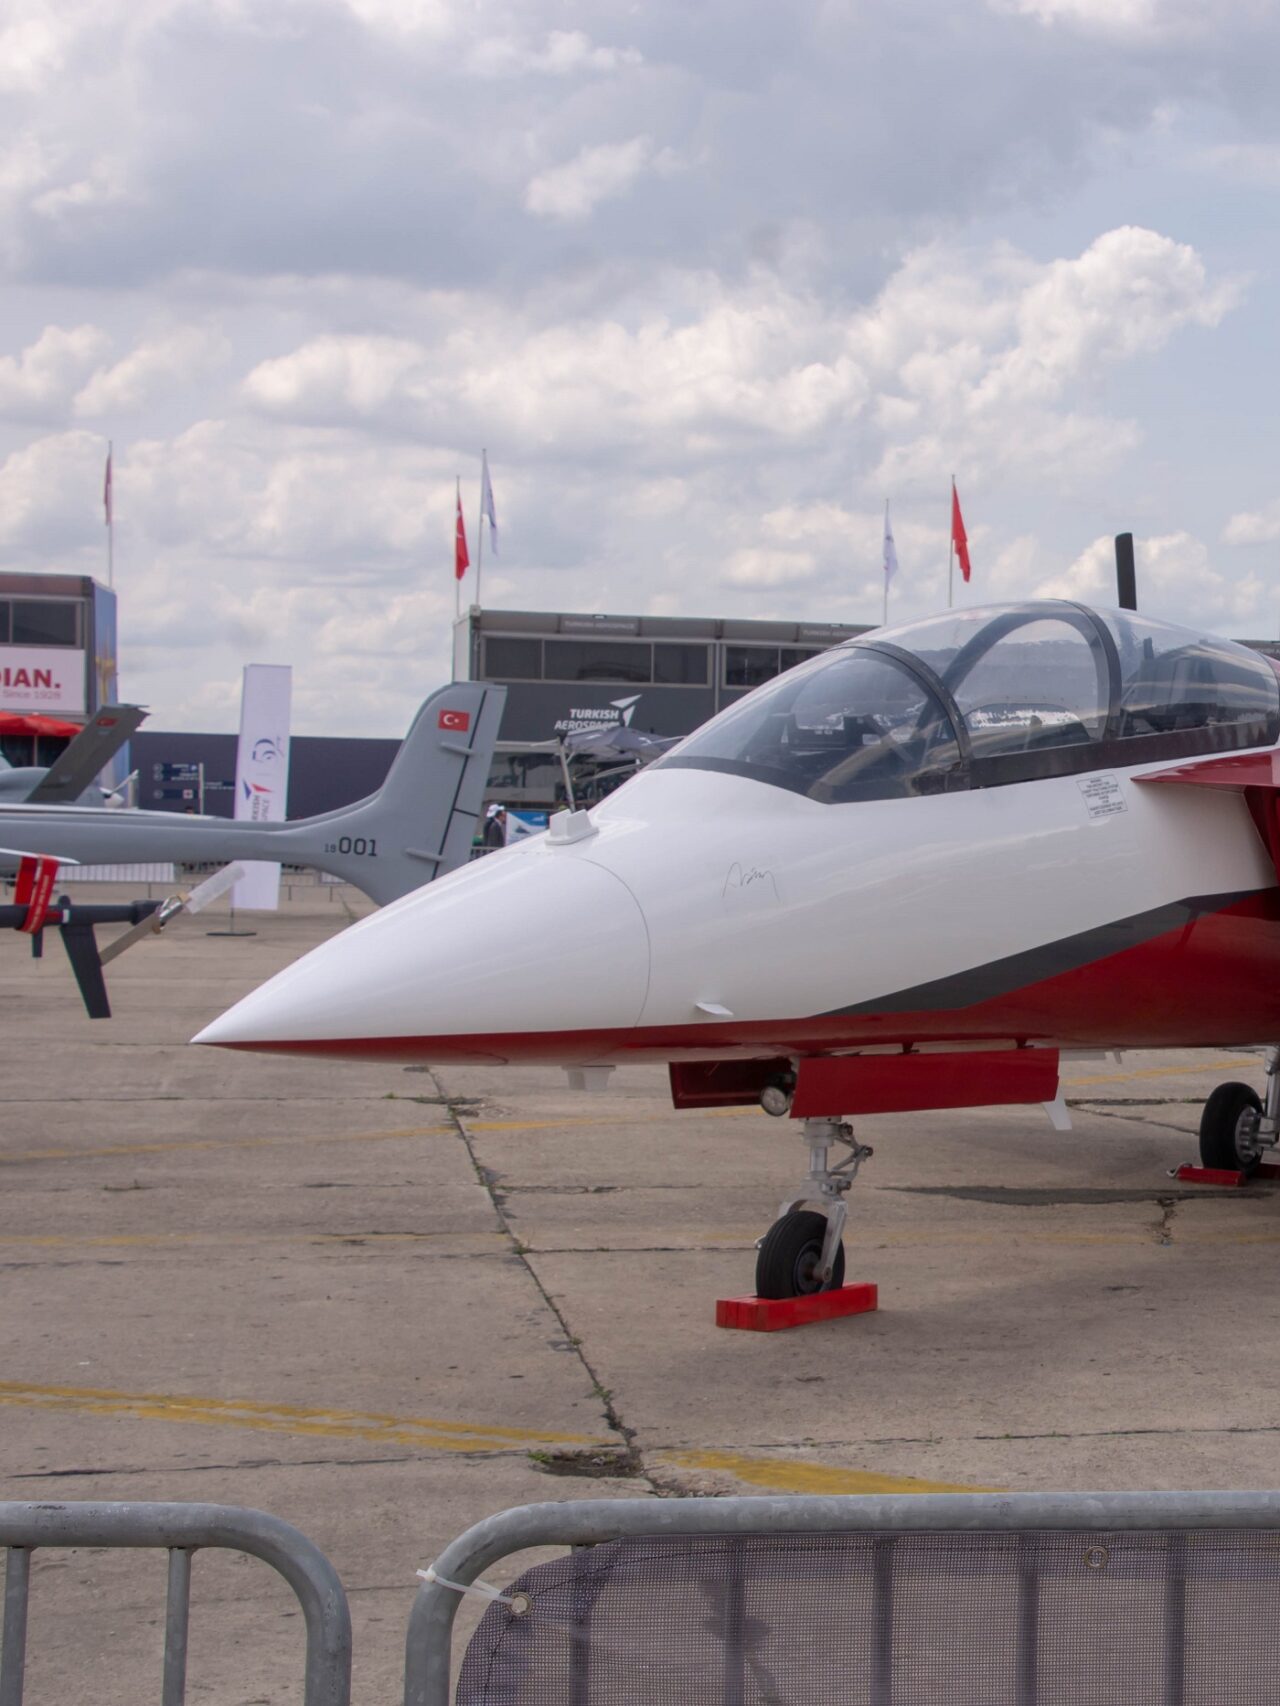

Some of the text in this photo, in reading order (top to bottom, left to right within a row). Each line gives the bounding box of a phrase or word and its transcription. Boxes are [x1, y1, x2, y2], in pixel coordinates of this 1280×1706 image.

[0, 667, 62, 689] IAN.
[569, 708, 620, 720] TURKISH
[338, 836, 378, 857] 001
